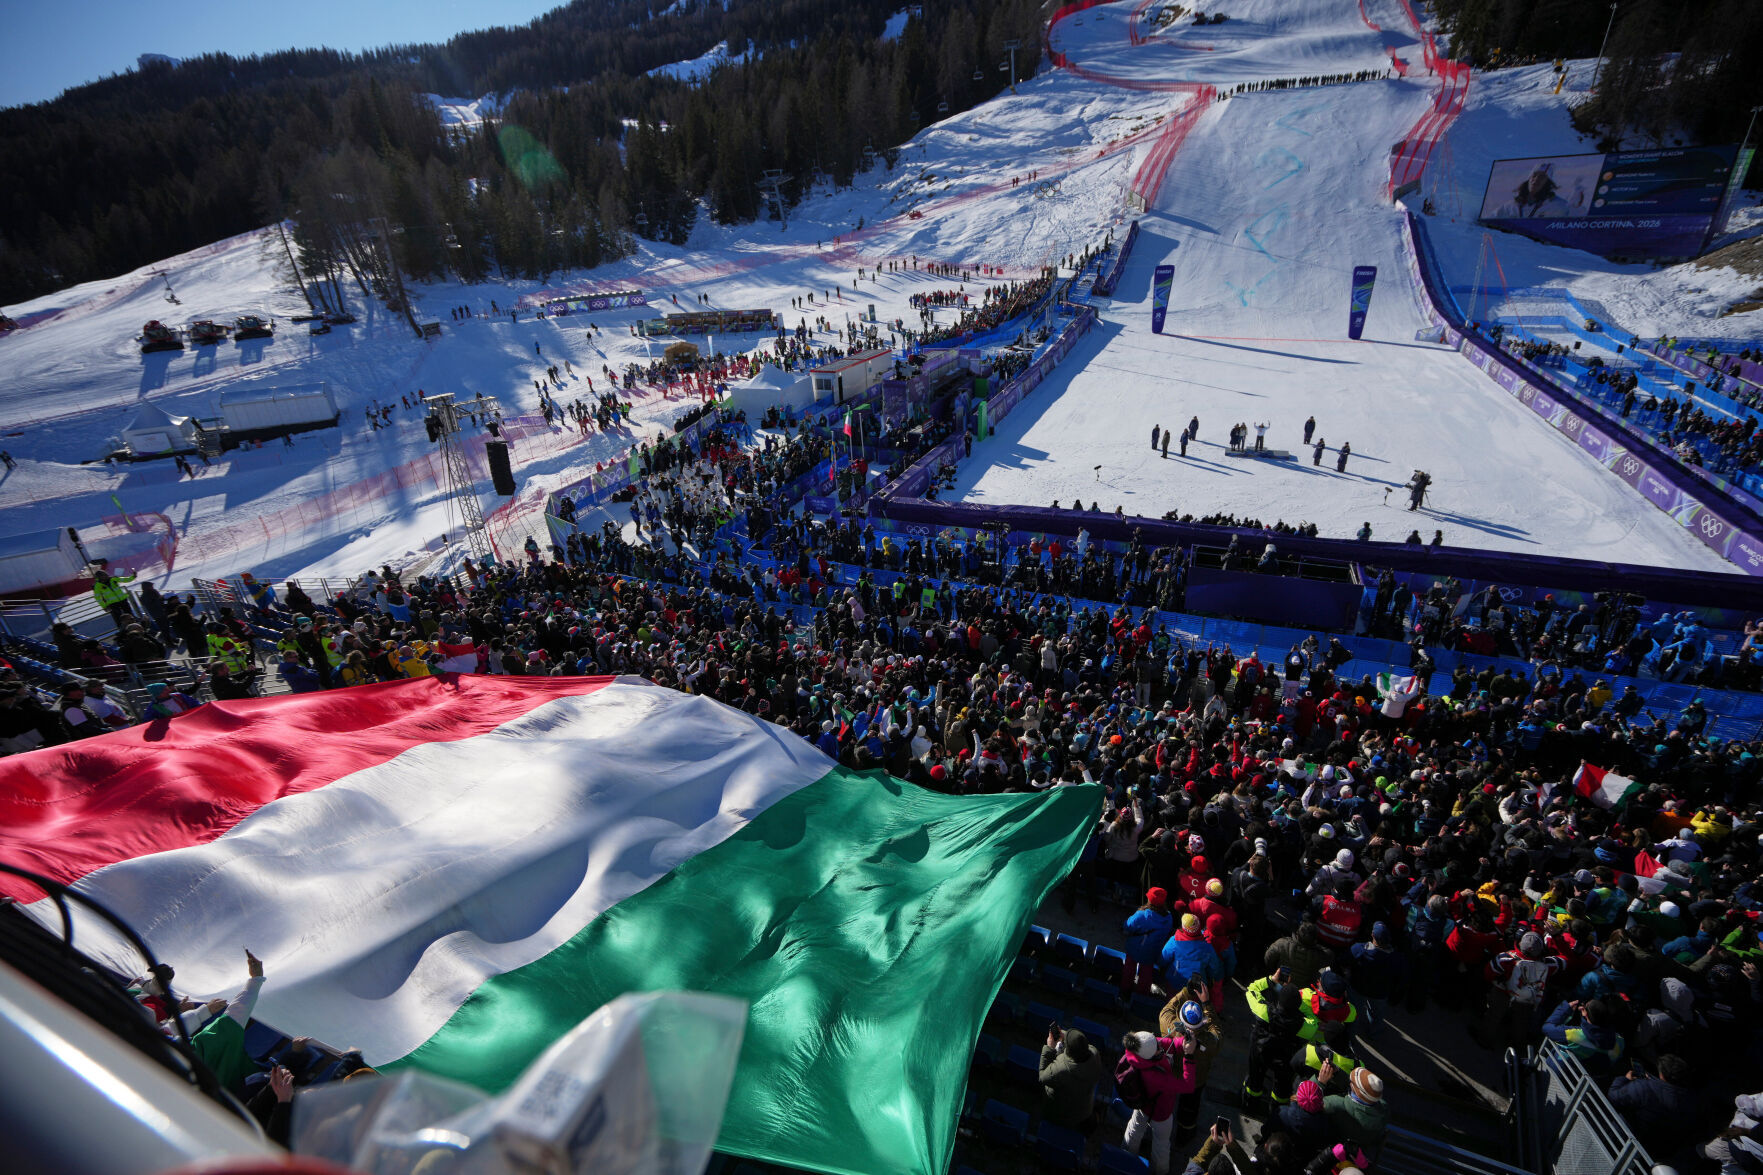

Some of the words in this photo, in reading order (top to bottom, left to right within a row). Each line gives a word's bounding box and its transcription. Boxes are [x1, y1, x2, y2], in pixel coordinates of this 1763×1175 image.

[1545, 221, 1588, 229] MILANO
[1589, 221, 1634, 229] CORTINA
[1637, 220, 1661, 228] 2026
[1326, 707, 1336, 718] 8
